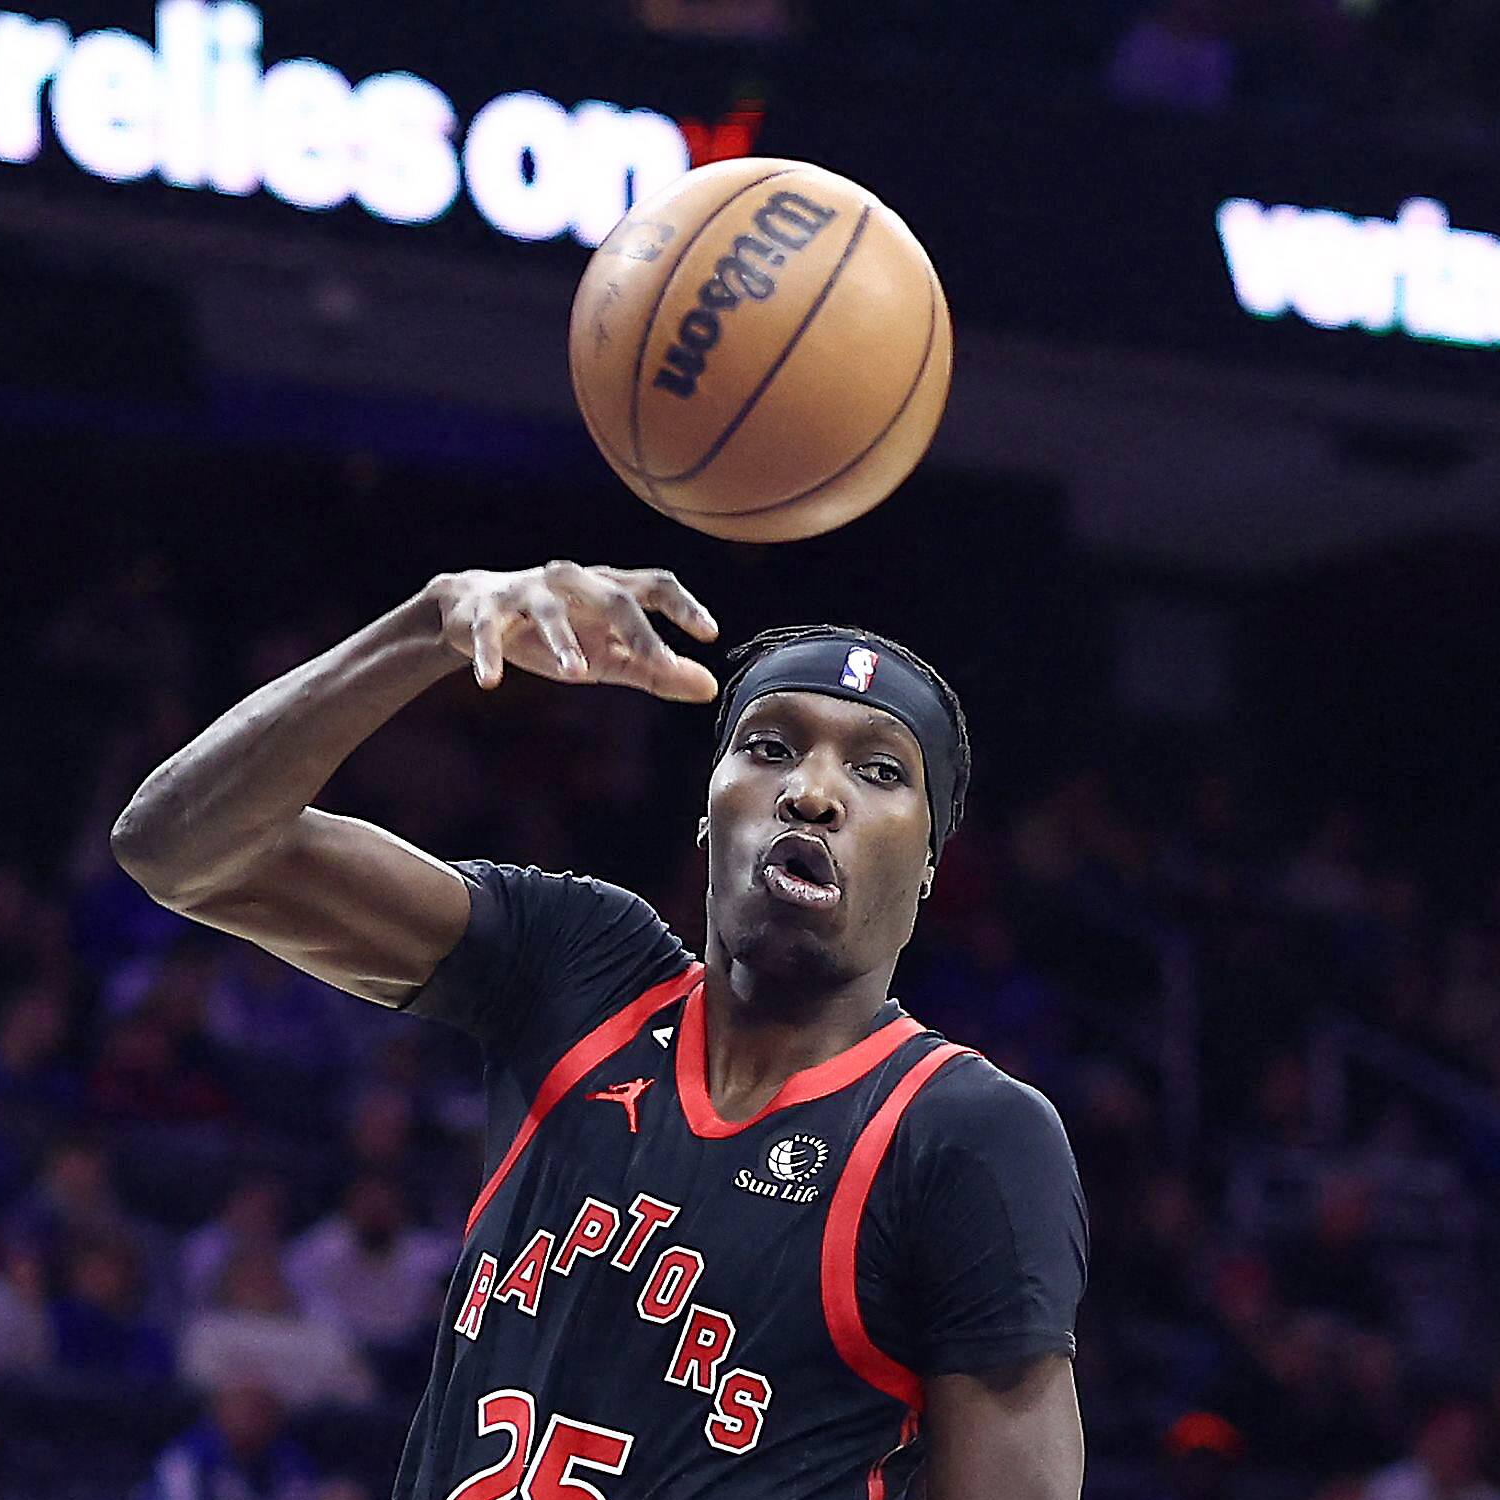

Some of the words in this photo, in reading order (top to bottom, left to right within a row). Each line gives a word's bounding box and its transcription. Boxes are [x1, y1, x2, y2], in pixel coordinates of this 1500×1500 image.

[464, 90, 690, 250] on
[653, 190, 837, 398] Wilson
[734, 1169, 779, 1197] Sun
[454, 1193, 772, 1455] RAPTORS
